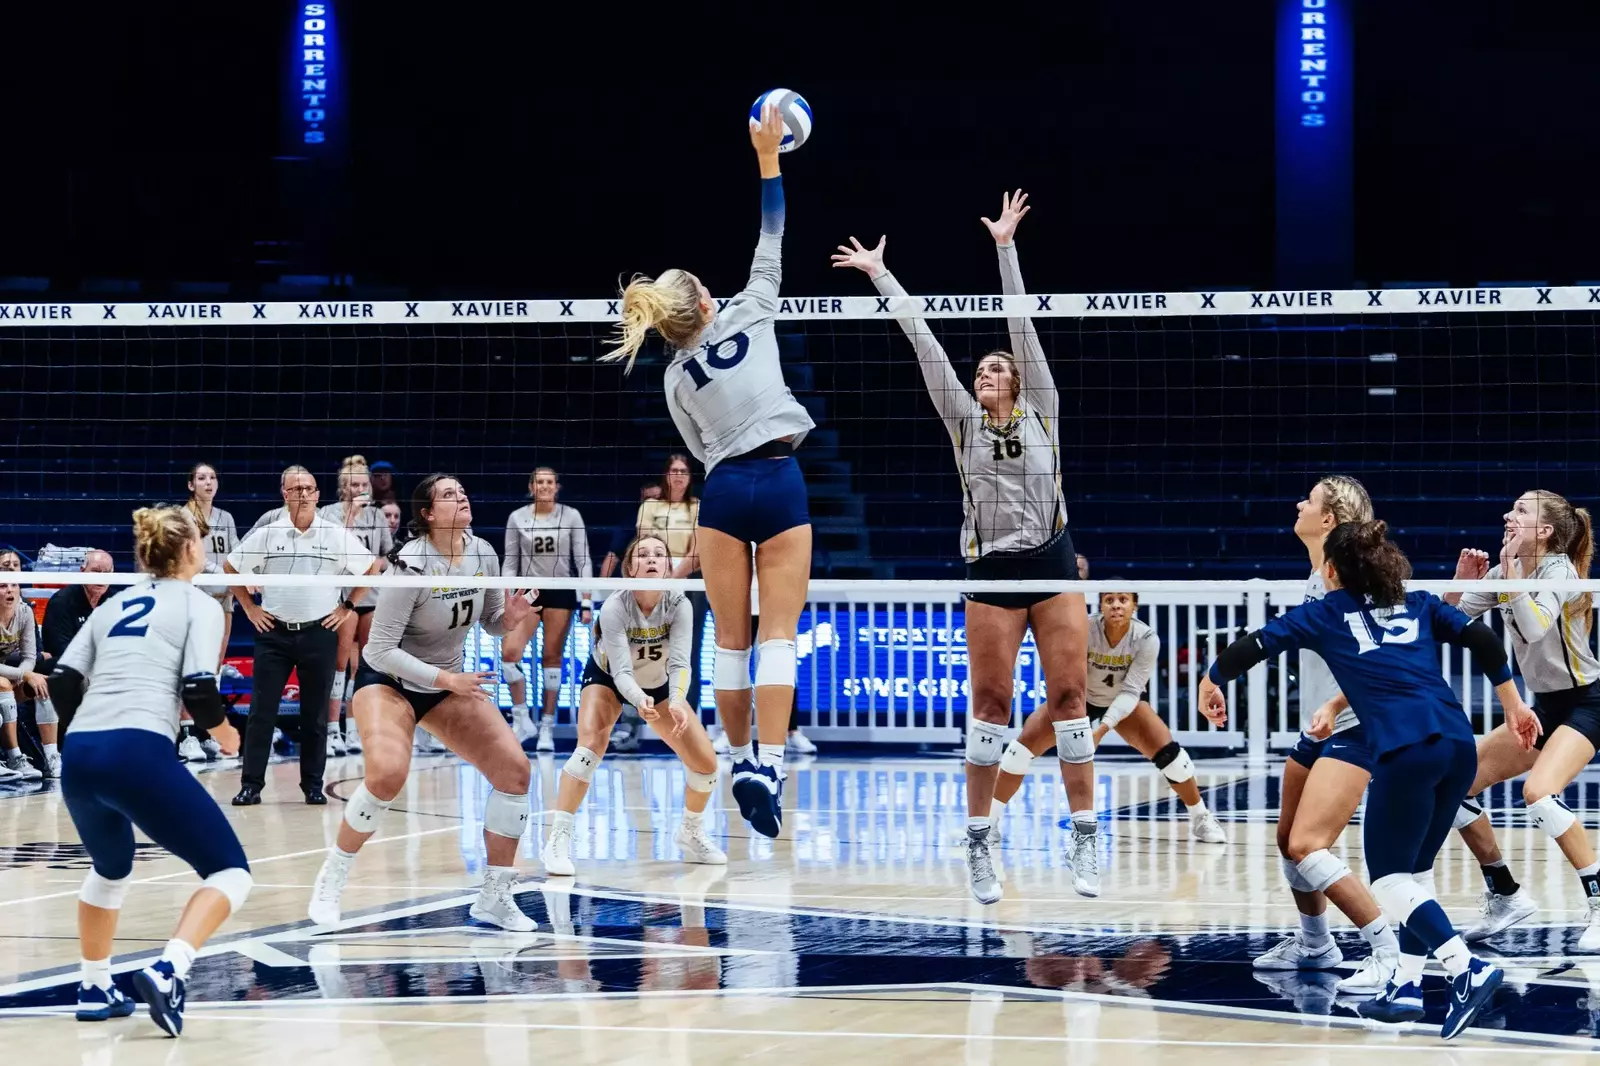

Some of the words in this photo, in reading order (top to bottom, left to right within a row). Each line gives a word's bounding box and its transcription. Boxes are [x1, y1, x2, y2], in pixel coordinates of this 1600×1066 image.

[0, 305, 71, 319] XAVIER
[102, 304, 117, 319] X
[147, 304, 222, 318] XAVIER
[252, 303, 267, 318] X
[298, 303, 374, 318] XAVIER
[404, 302, 420, 317] X
[451, 301, 528, 316] XAVIER
[559, 301, 574, 316] X
[779, 298, 843, 313] AVIER
[875, 297, 891, 312] X
[923, 296, 1004, 312] XAVIER
[1036, 295, 1053, 310] X
[1085, 294, 1167, 310] XAVIER
[1200, 293, 1217, 309] X
[1250, 292, 1333, 307] XAVIER
[1367, 290, 1383, 306] X
[1417, 289, 1502, 305] XAVIER
[1536, 288, 1553, 304] X
[682, 331, 749, 391] 10
[992, 436, 1022, 460] 16
[211, 535, 225, 554] 19
[534, 536, 555, 553] 22
[107, 596, 156, 637] 2
[448, 599, 473, 629] 17
[1343, 604, 1419, 654] 15
[637, 644, 662, 661] 15
[1102, 673, 1114, 688] 4
